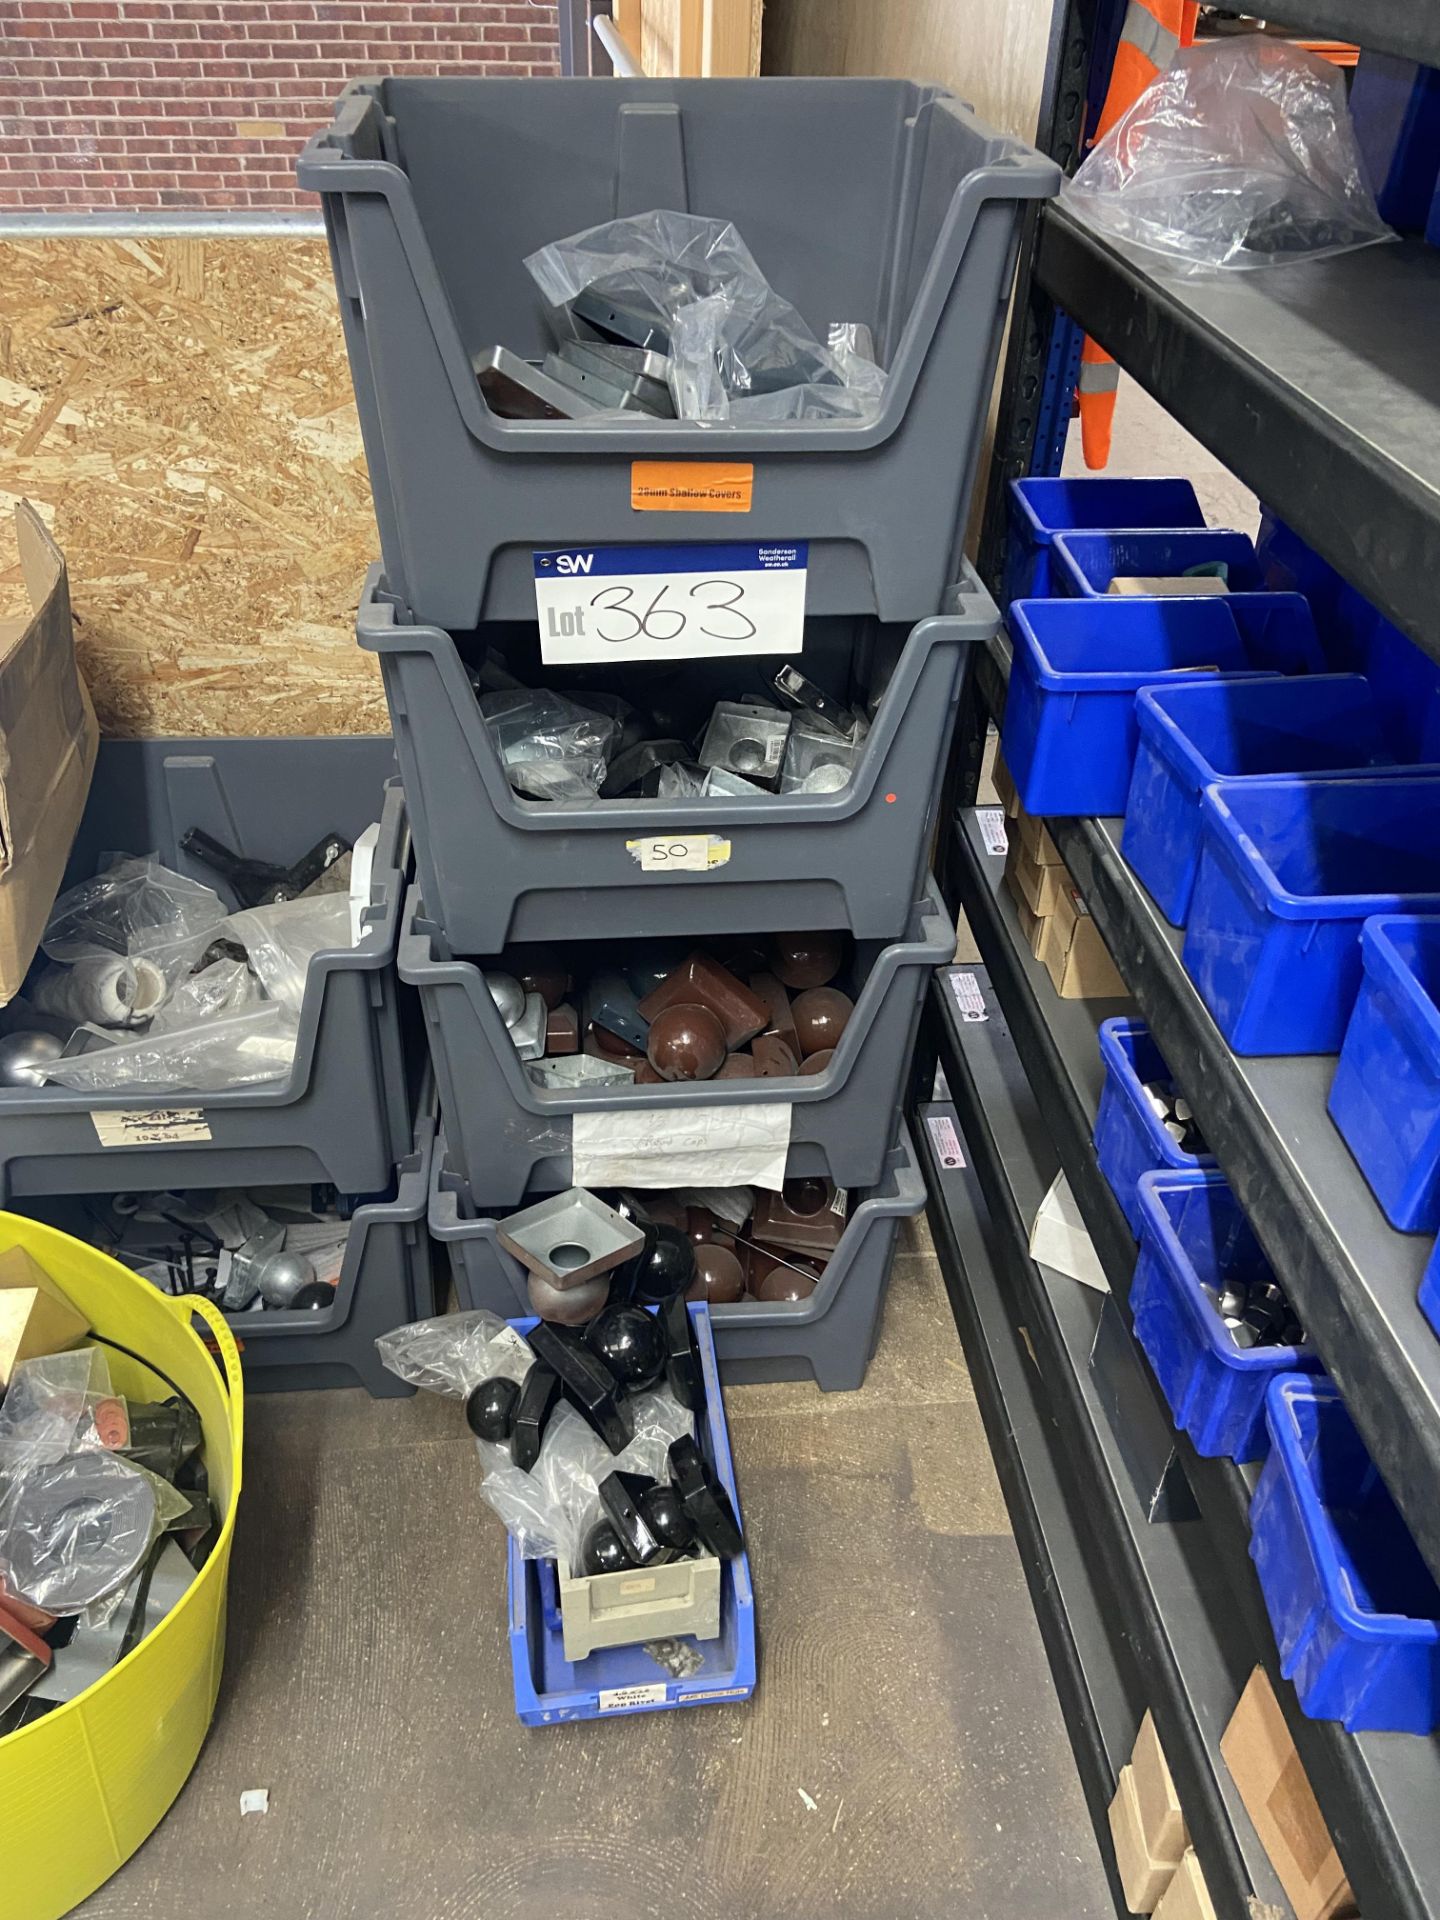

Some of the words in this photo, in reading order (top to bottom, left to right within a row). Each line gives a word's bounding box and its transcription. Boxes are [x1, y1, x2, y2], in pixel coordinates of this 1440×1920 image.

[669, 487, 707, 498] Shallow
[708, 488, 742, 499] Covers
[758, 547, 797, 555] Sanderson
[758, 554, 796, 562] Weatherall
[556, 554, 594, 574] SW
[547, 605, 586, 637] Lot
[590, 580, 757, 643] 363
[652, 844, 689, 861] 50
